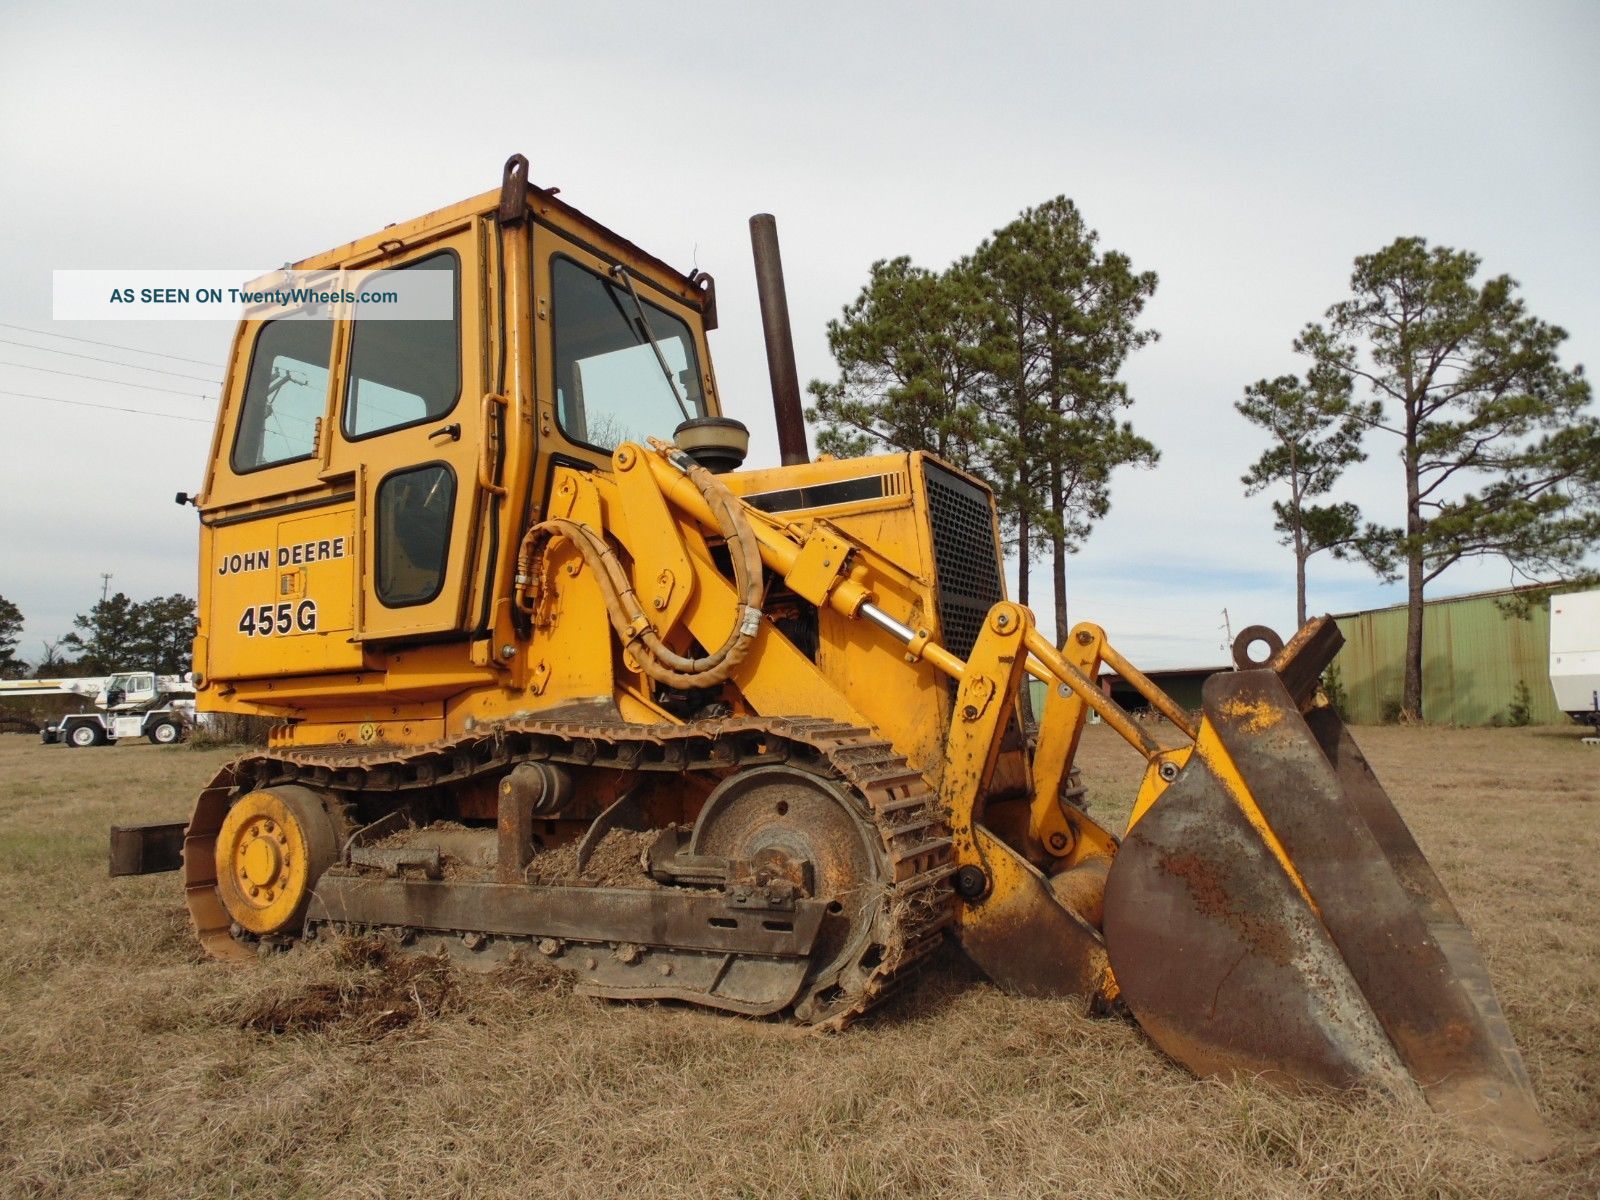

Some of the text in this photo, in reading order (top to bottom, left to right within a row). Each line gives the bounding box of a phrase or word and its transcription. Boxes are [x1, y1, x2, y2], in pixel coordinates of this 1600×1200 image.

[218, 537, 344, 576] JOHN DEERE
[238, 599, 317, 637] 455G
